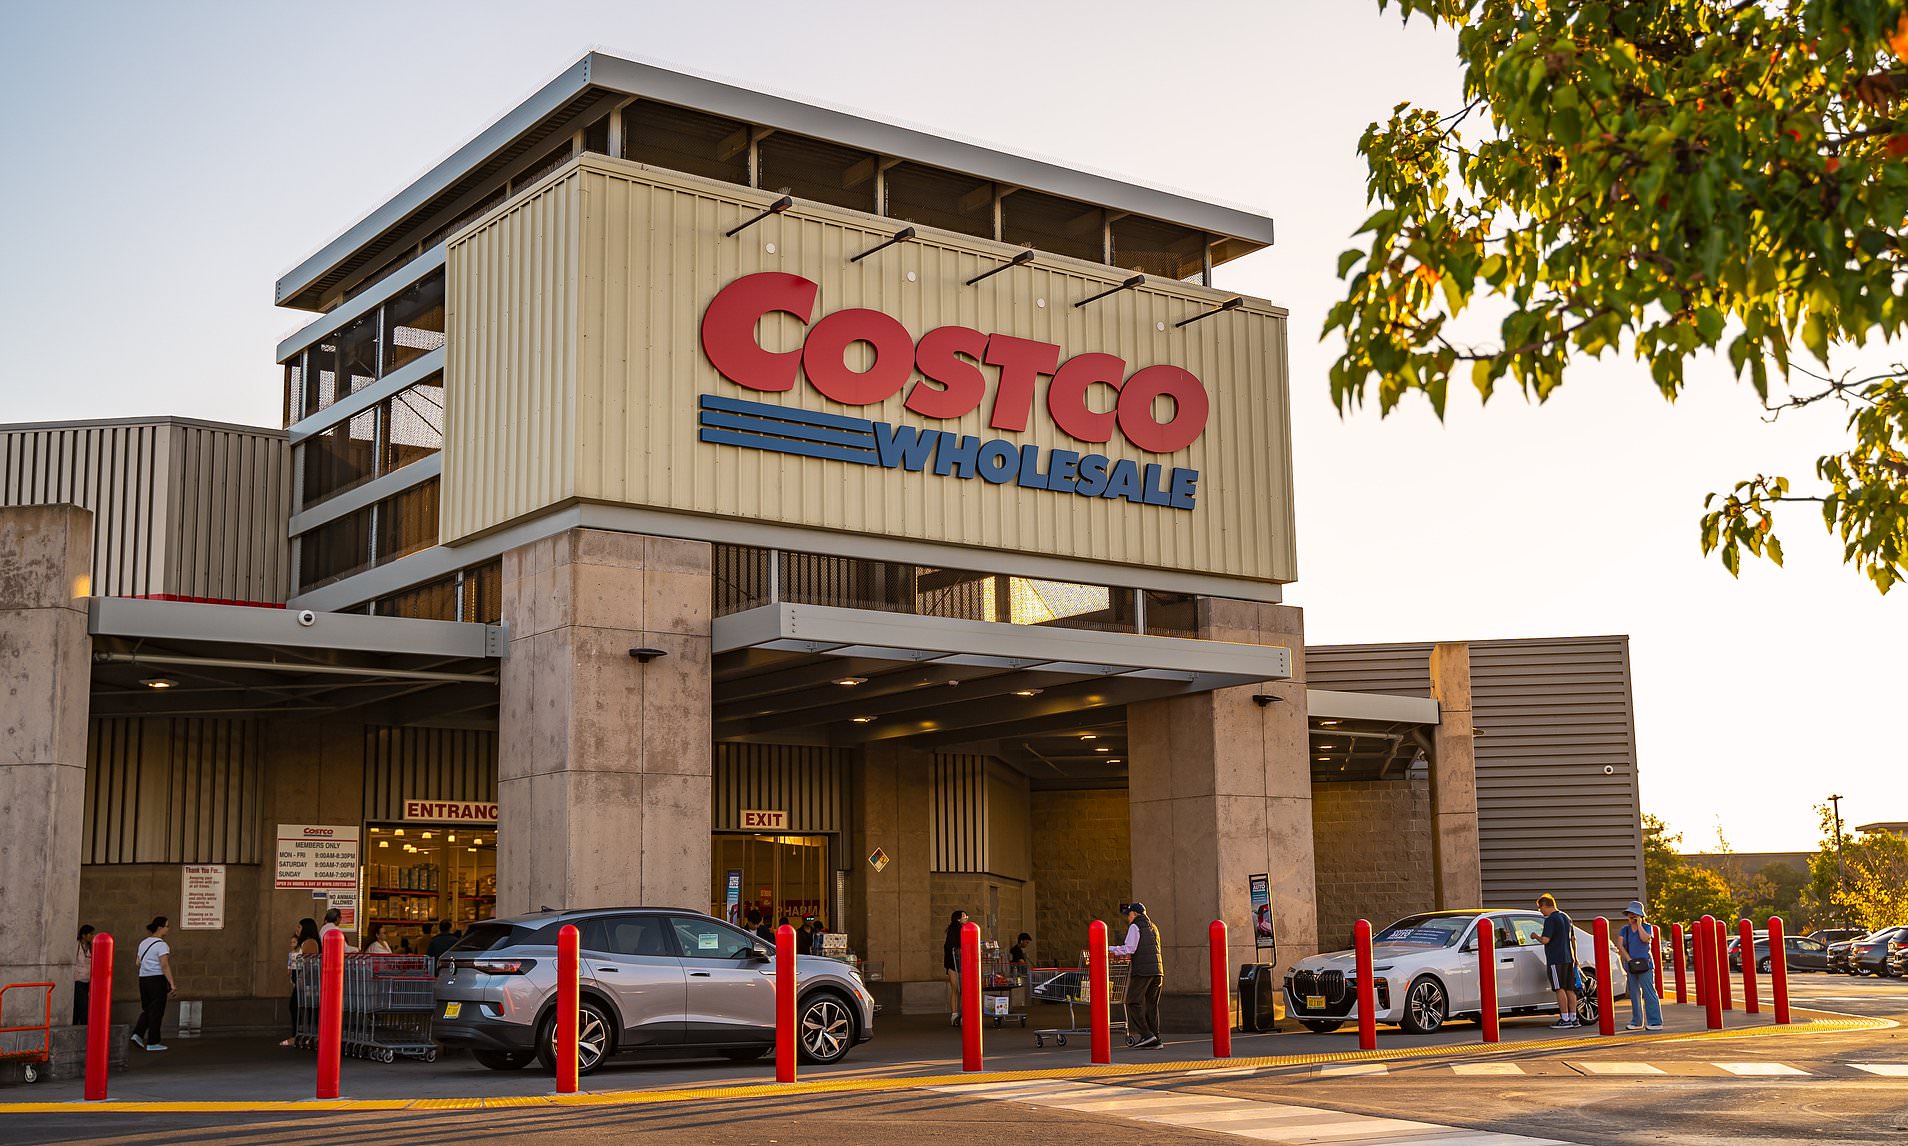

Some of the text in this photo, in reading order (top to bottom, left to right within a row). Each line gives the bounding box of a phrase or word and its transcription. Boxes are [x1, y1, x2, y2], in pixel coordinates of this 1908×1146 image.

[700, 271, 1209, 454] COSTCO
[873, 421, 1199, 510] WHOLESALE
[745, 812, 783, 826] EXIT
